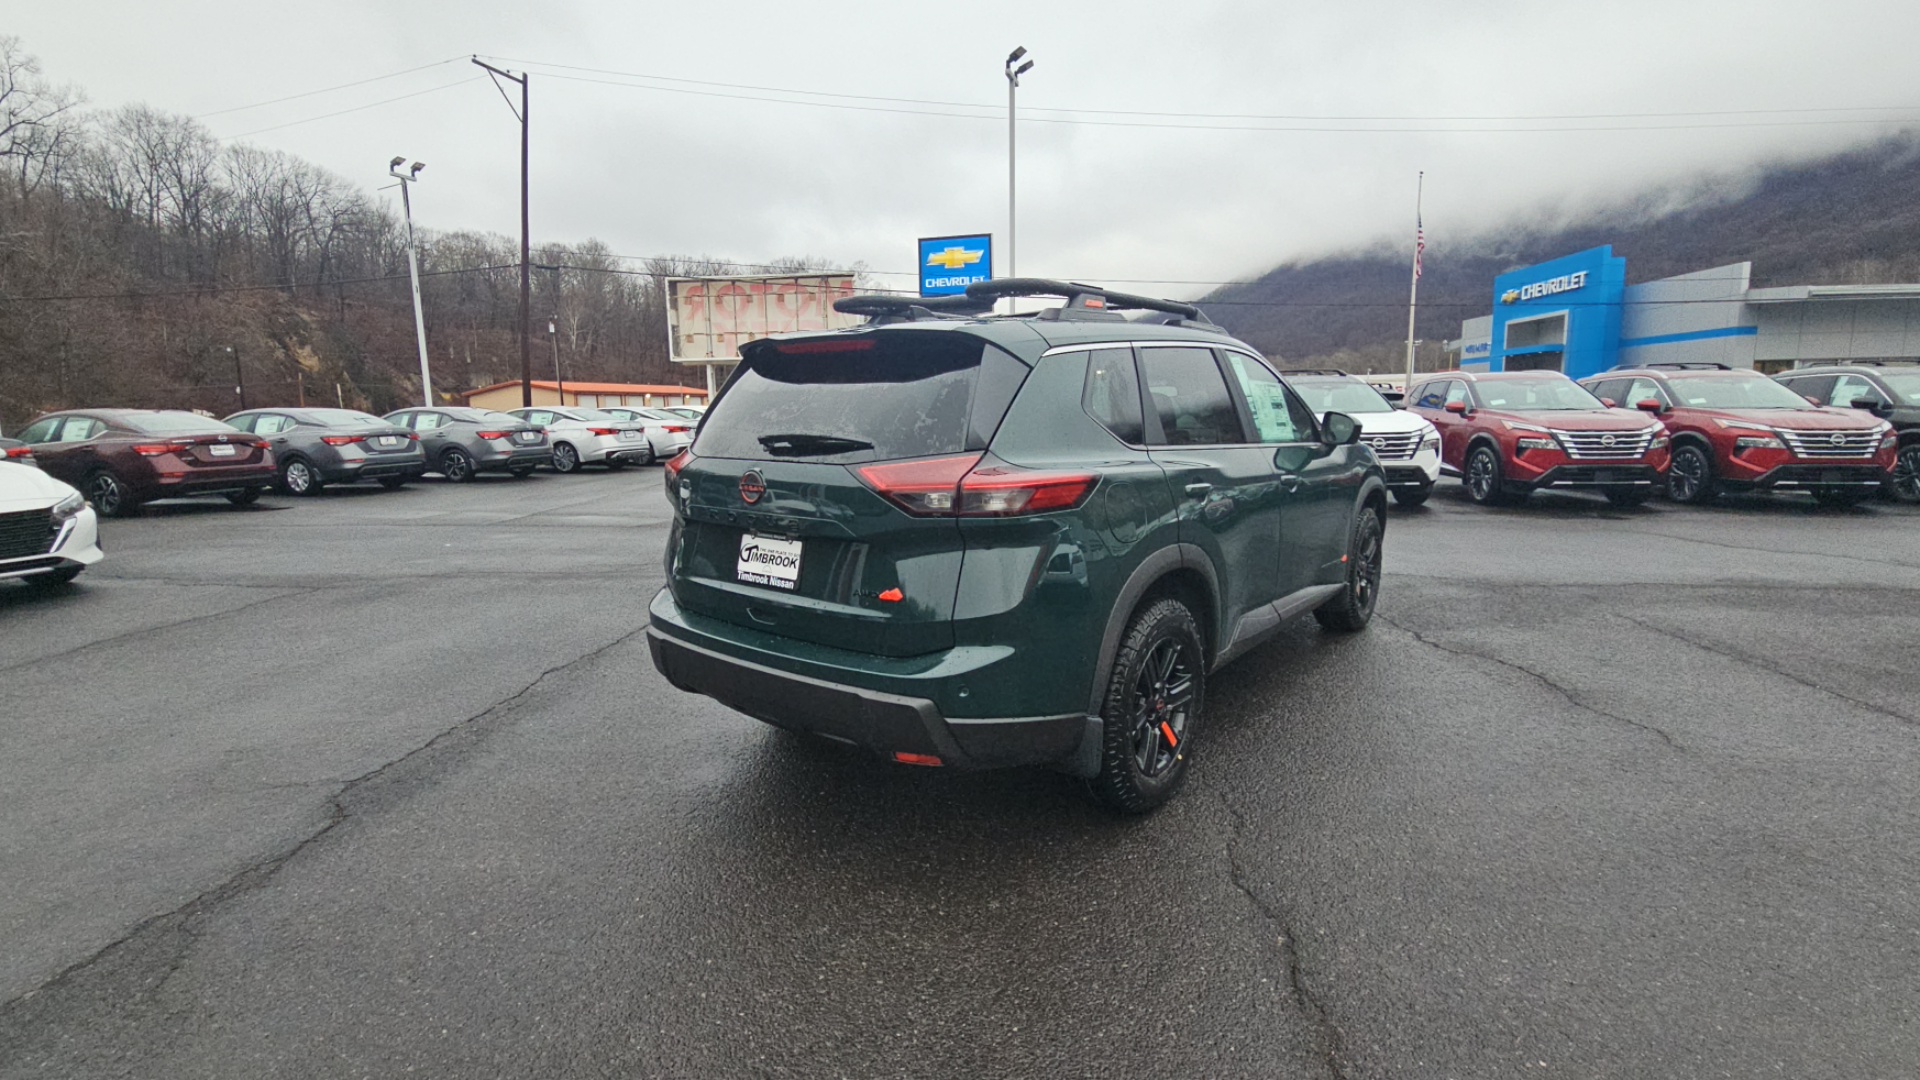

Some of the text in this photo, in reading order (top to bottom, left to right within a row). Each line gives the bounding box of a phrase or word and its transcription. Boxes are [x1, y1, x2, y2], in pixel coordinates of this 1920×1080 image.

[1521, 271, 1588, 300] CHEVROLET
[739, 543, 799, 569] TIMBROOK
[737, 570, 795, 590] Timbrook Nissan
